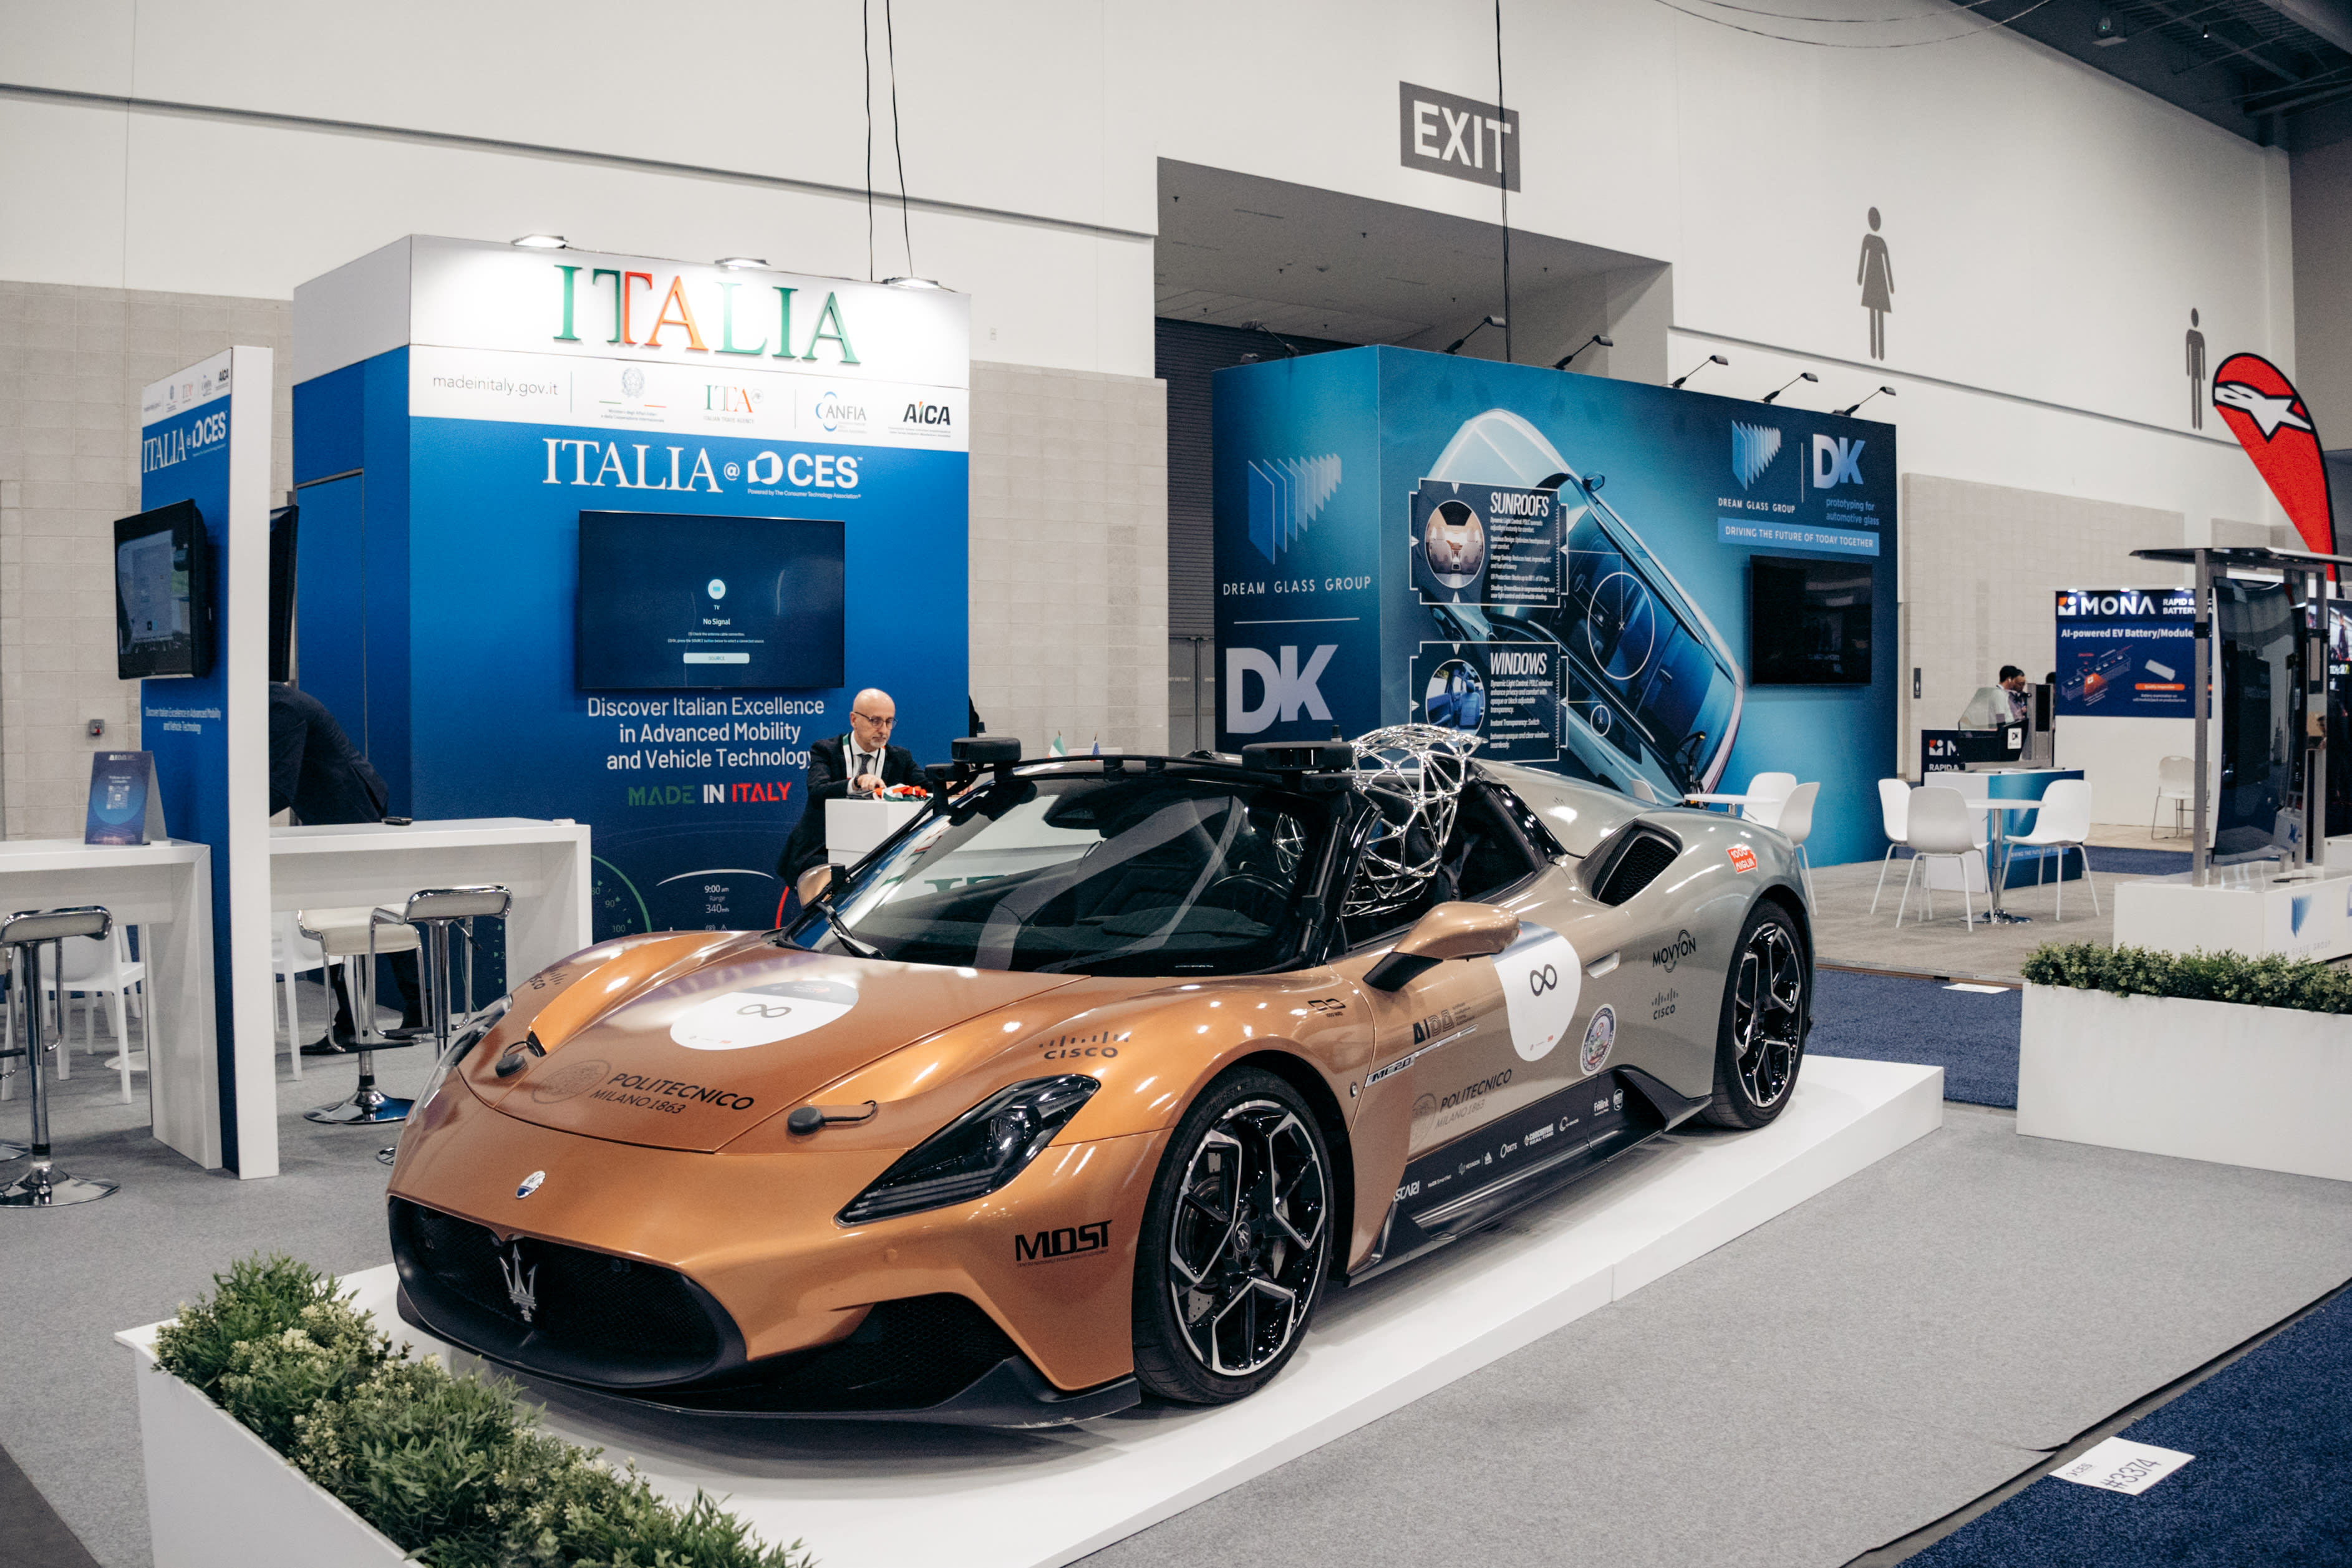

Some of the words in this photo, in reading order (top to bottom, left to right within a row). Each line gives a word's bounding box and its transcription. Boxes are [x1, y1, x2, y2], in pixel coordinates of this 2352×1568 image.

[1414, 100, 1511, 173] EXIT
[553, 264, 861, 365] ITALIA
[433, 375, 558, 396] madeinitaly.gov.it
[825, 405, 867, 421] ANFIA
[903, 401, 951, 425] AICA
[143, 428, 186, 473] ITALIA
[203, 412, 226, 444] CES
[542, 438, 724, 493] ITALIA
[724, 462, 740, 481] @
[1812, 434, 1866, 489] DK
[1490, 491, 1549, 517] SUNROOFS
[1718, 498, 1743, 508] DREAM
[1746, 501, 1768, 511] GLASS
[1773, 504, 1795, 513] GROUP
[1826, 499, 1864, 511] prototyping
[1866, 501, 1874, 510] for
[1826, 512, 1862, 524] automotive
[1864, 515, 1879, 526] glass
[1725, 526, 1756, 537] DRIVING
[1759, 529, 1773, 539] THE
[1775, 531, 1802, 541] FUTURE
[1804, 533, 1814, 541] OF
[1816, 534, 1837, 544] TODAY
[1840, 536, 1874, 548] TOGETHER
[1223, 581, 1265, 595] DREAM
[1274, 579, 1315, 593] GLASS
[1325, 576, 1371, 591] GROUP
[2081, 596, 2156, 615] MONA
[2061, 629, 2109, 639] AI-powered
[1490, 652, 1547, 675] WINDOWS
[1226, 644, 1338, 733] DK
[588, 697, 669, 717] Discover
[674, 697, 727, 716] Italian
[732, 697, 825, 715] Excellence
[619, 724, 636, 743] in
[640, 723, 729, 743] Advanced
[734, 722, 801, 744] Mobility
[607, 751, 641, 770] and
[645, 750, 711, 769] Vehicle
[629, 785, 695, 806] MADE
[704, 784, 724, 803] IN
[732, 782, 792, 802] ITALY
[705, 885, 720, 893] 9:00
[605, 900, 615, 908] 90
[1653, 938, 1696, 967] MOVYON
[1653, 1004, 1675, 1020] CISCO
[1413, 1009, 1454, 1045] AIDA
[1044, 1047, 1118, 1059] CISCO
[1372, 1057, 1411, 1082] MC20
[589, 1089, 651, 1107] MILANO
[647, 1100, 686, 1114] 1863
[607, 1073, 755, 1110] POLITECNICO
[1440, 1069, 1512, 1112] POLITECNICO
[1435, 1108, 1466, 1128] MILANO
[1467, 1099, 1485, 1115] 1863
[1393, 1181, 1420, 1202] SCARI
[1015, 1219, 1113, 1261] MOST
[2101, 1458, 2161, 1489] #3374
